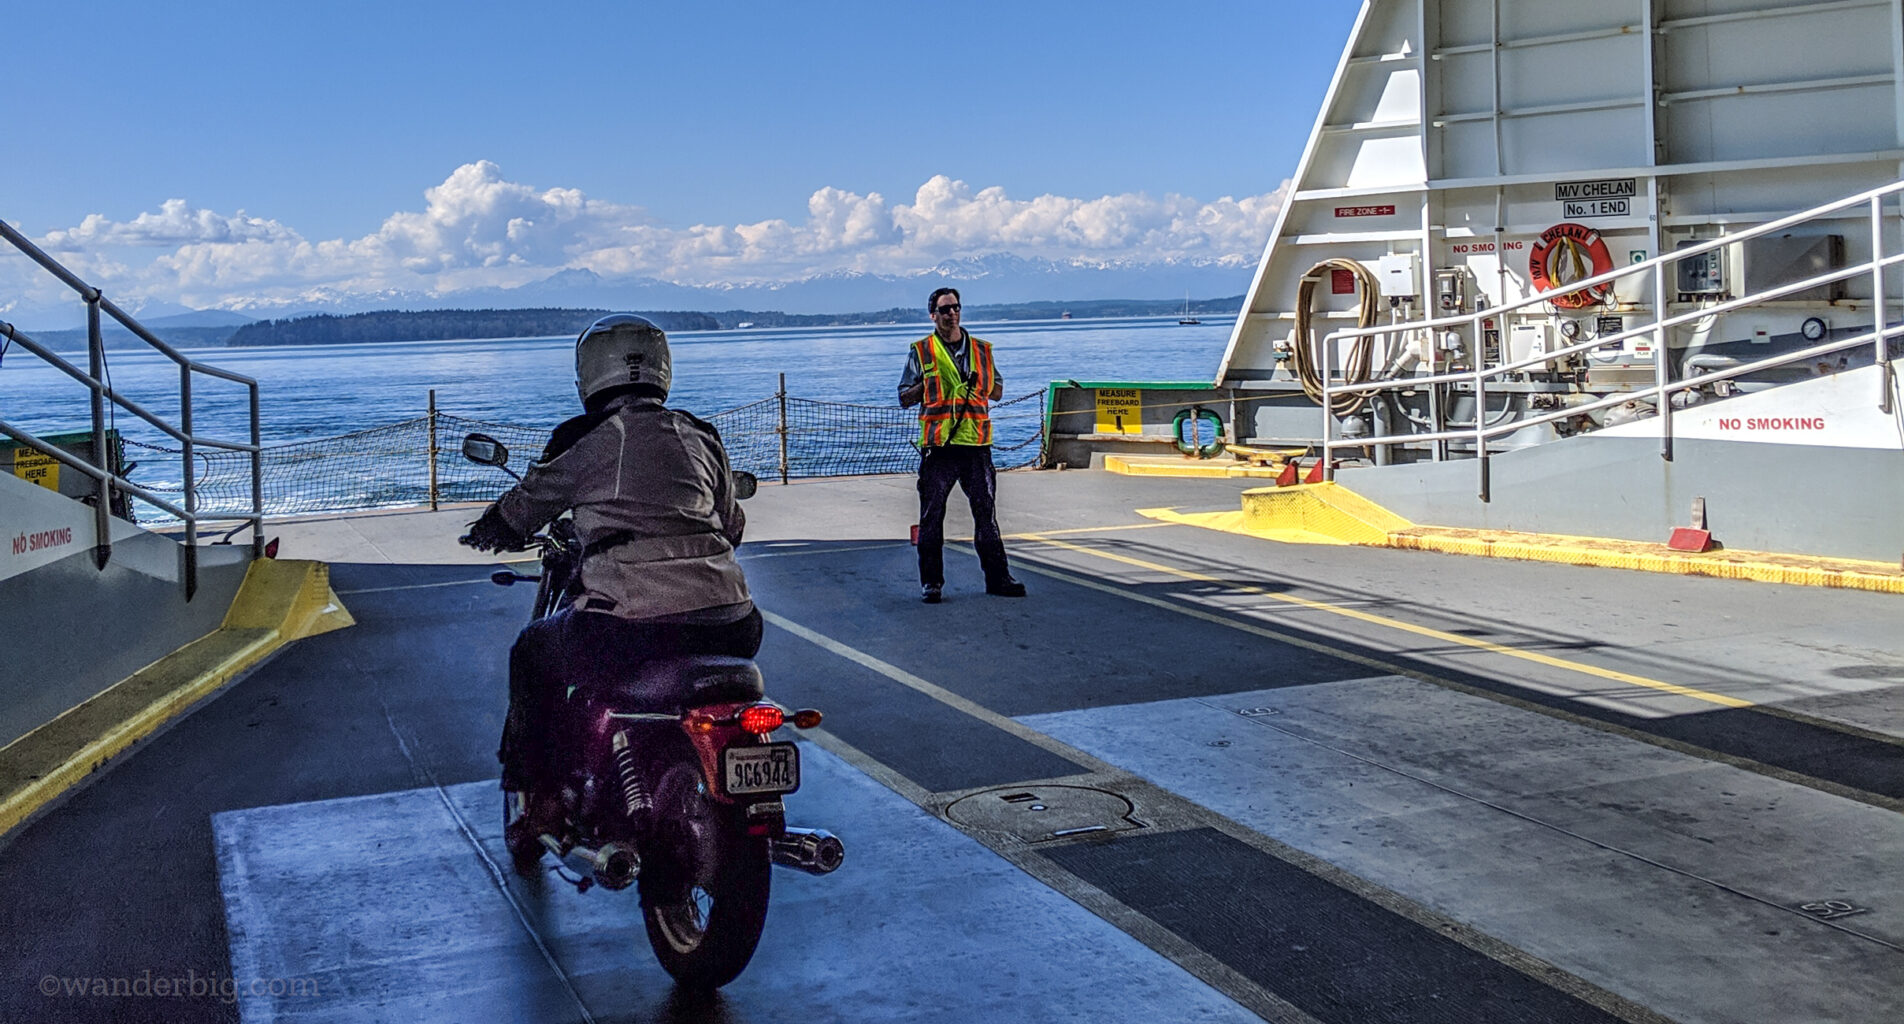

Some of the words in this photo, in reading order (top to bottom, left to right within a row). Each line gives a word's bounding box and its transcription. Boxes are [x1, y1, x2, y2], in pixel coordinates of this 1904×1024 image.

[1558, 184, 1579, 198] M/V
[1582, 181, 1633, 196] CHELAN
[1338, 208, 1355, 216] FIRE
[1356, 207, 1377, 216] ZONE
[1567, 203, 1587, 216] No.
[1590, 203, 1597, 215] 1
[1600, 201, 1627, 214] END
[1543, 227, 1583, 243] CHELAN
[1452, 244, 1469, 254] NO
[1471, 241, 1523, 253] SMOING
[1099, 389, 1137, 398] MEASURE
[1106, 406, 1129, 416] HERE
[1719, 418, 1742, 430] NO
[1746, 417, 1825, 430] SMOKING
[25, 468, 47, 479] HERE
[13, 535, 27, 555] NO
[29, 527, 72, 552] SMOKING
[734, 761, 792, 788] 9C6944
